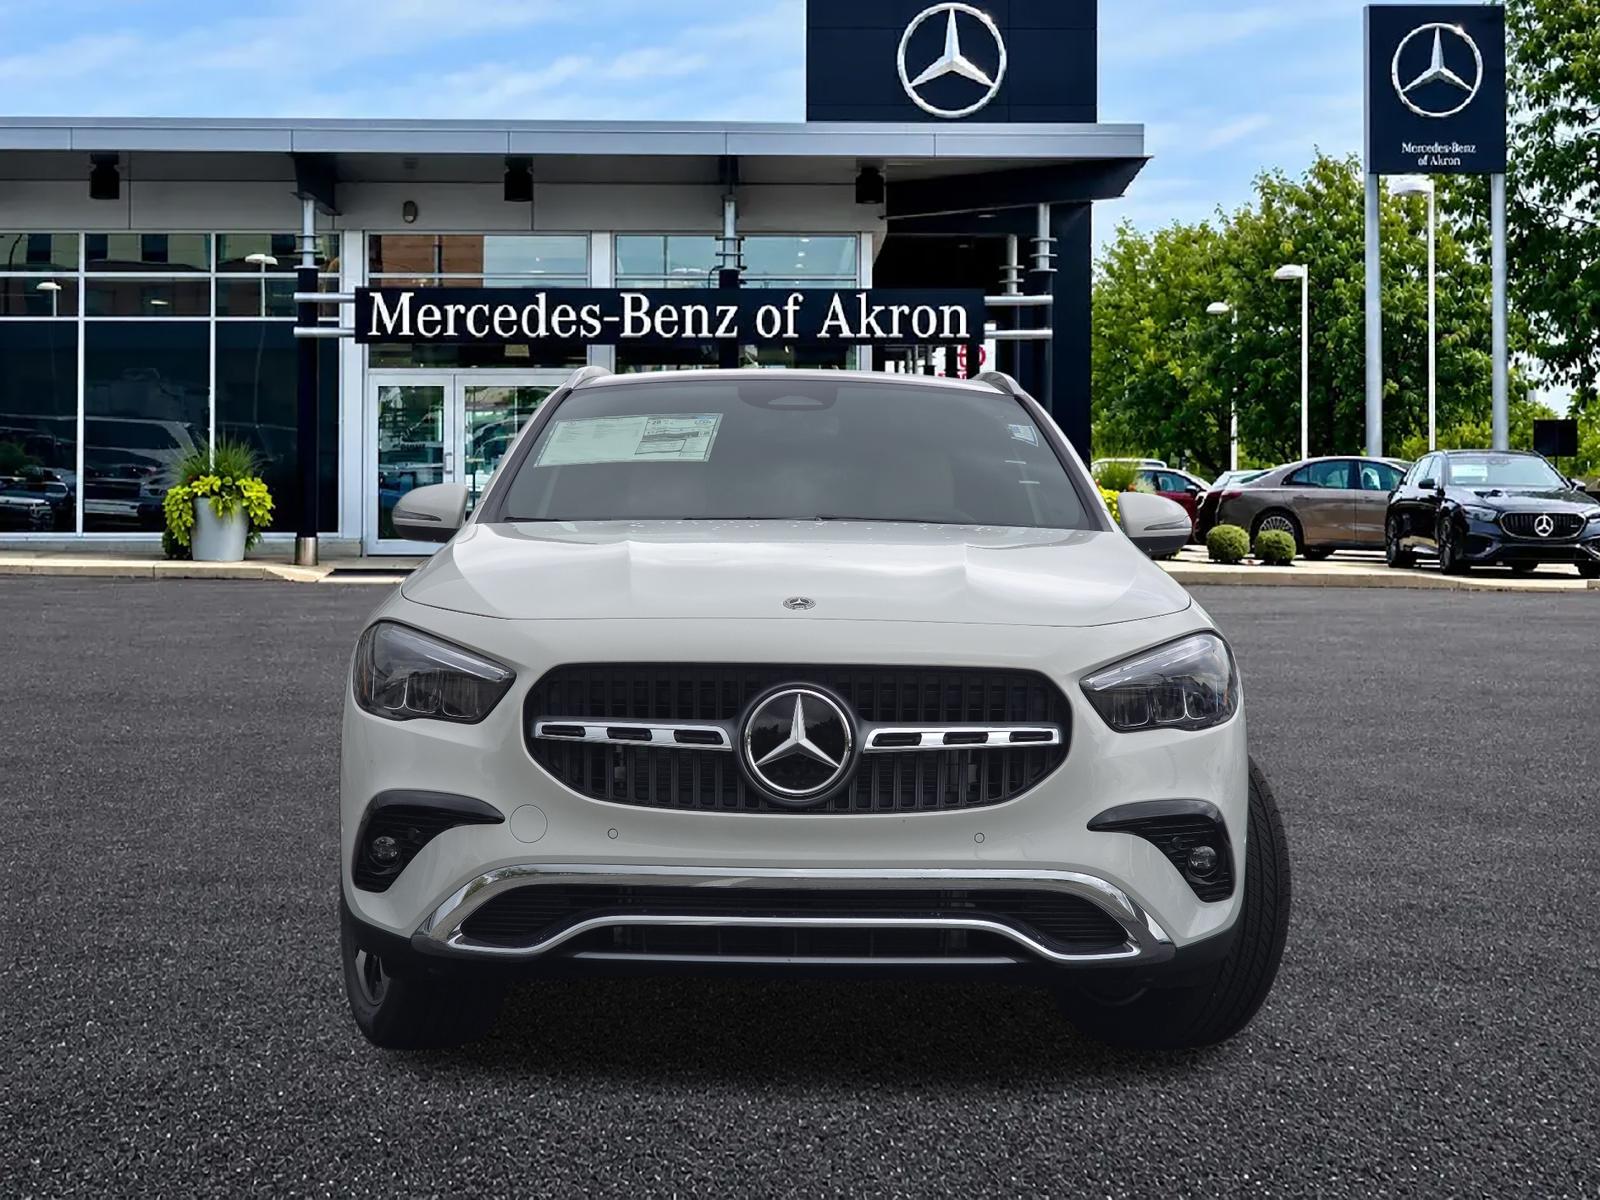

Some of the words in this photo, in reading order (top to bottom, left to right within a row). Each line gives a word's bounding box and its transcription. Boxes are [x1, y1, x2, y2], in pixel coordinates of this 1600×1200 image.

[1401, 141, 1477, 154] Mercedes-Benz
[1418, 155, 1428, 166] of
[1430, 155, 1461, 166] Akron
[368, 292, 738, 338] Mercedes-Benz
[756, 292, 803, 338] of
[817, 292, 970, 338] Akron
